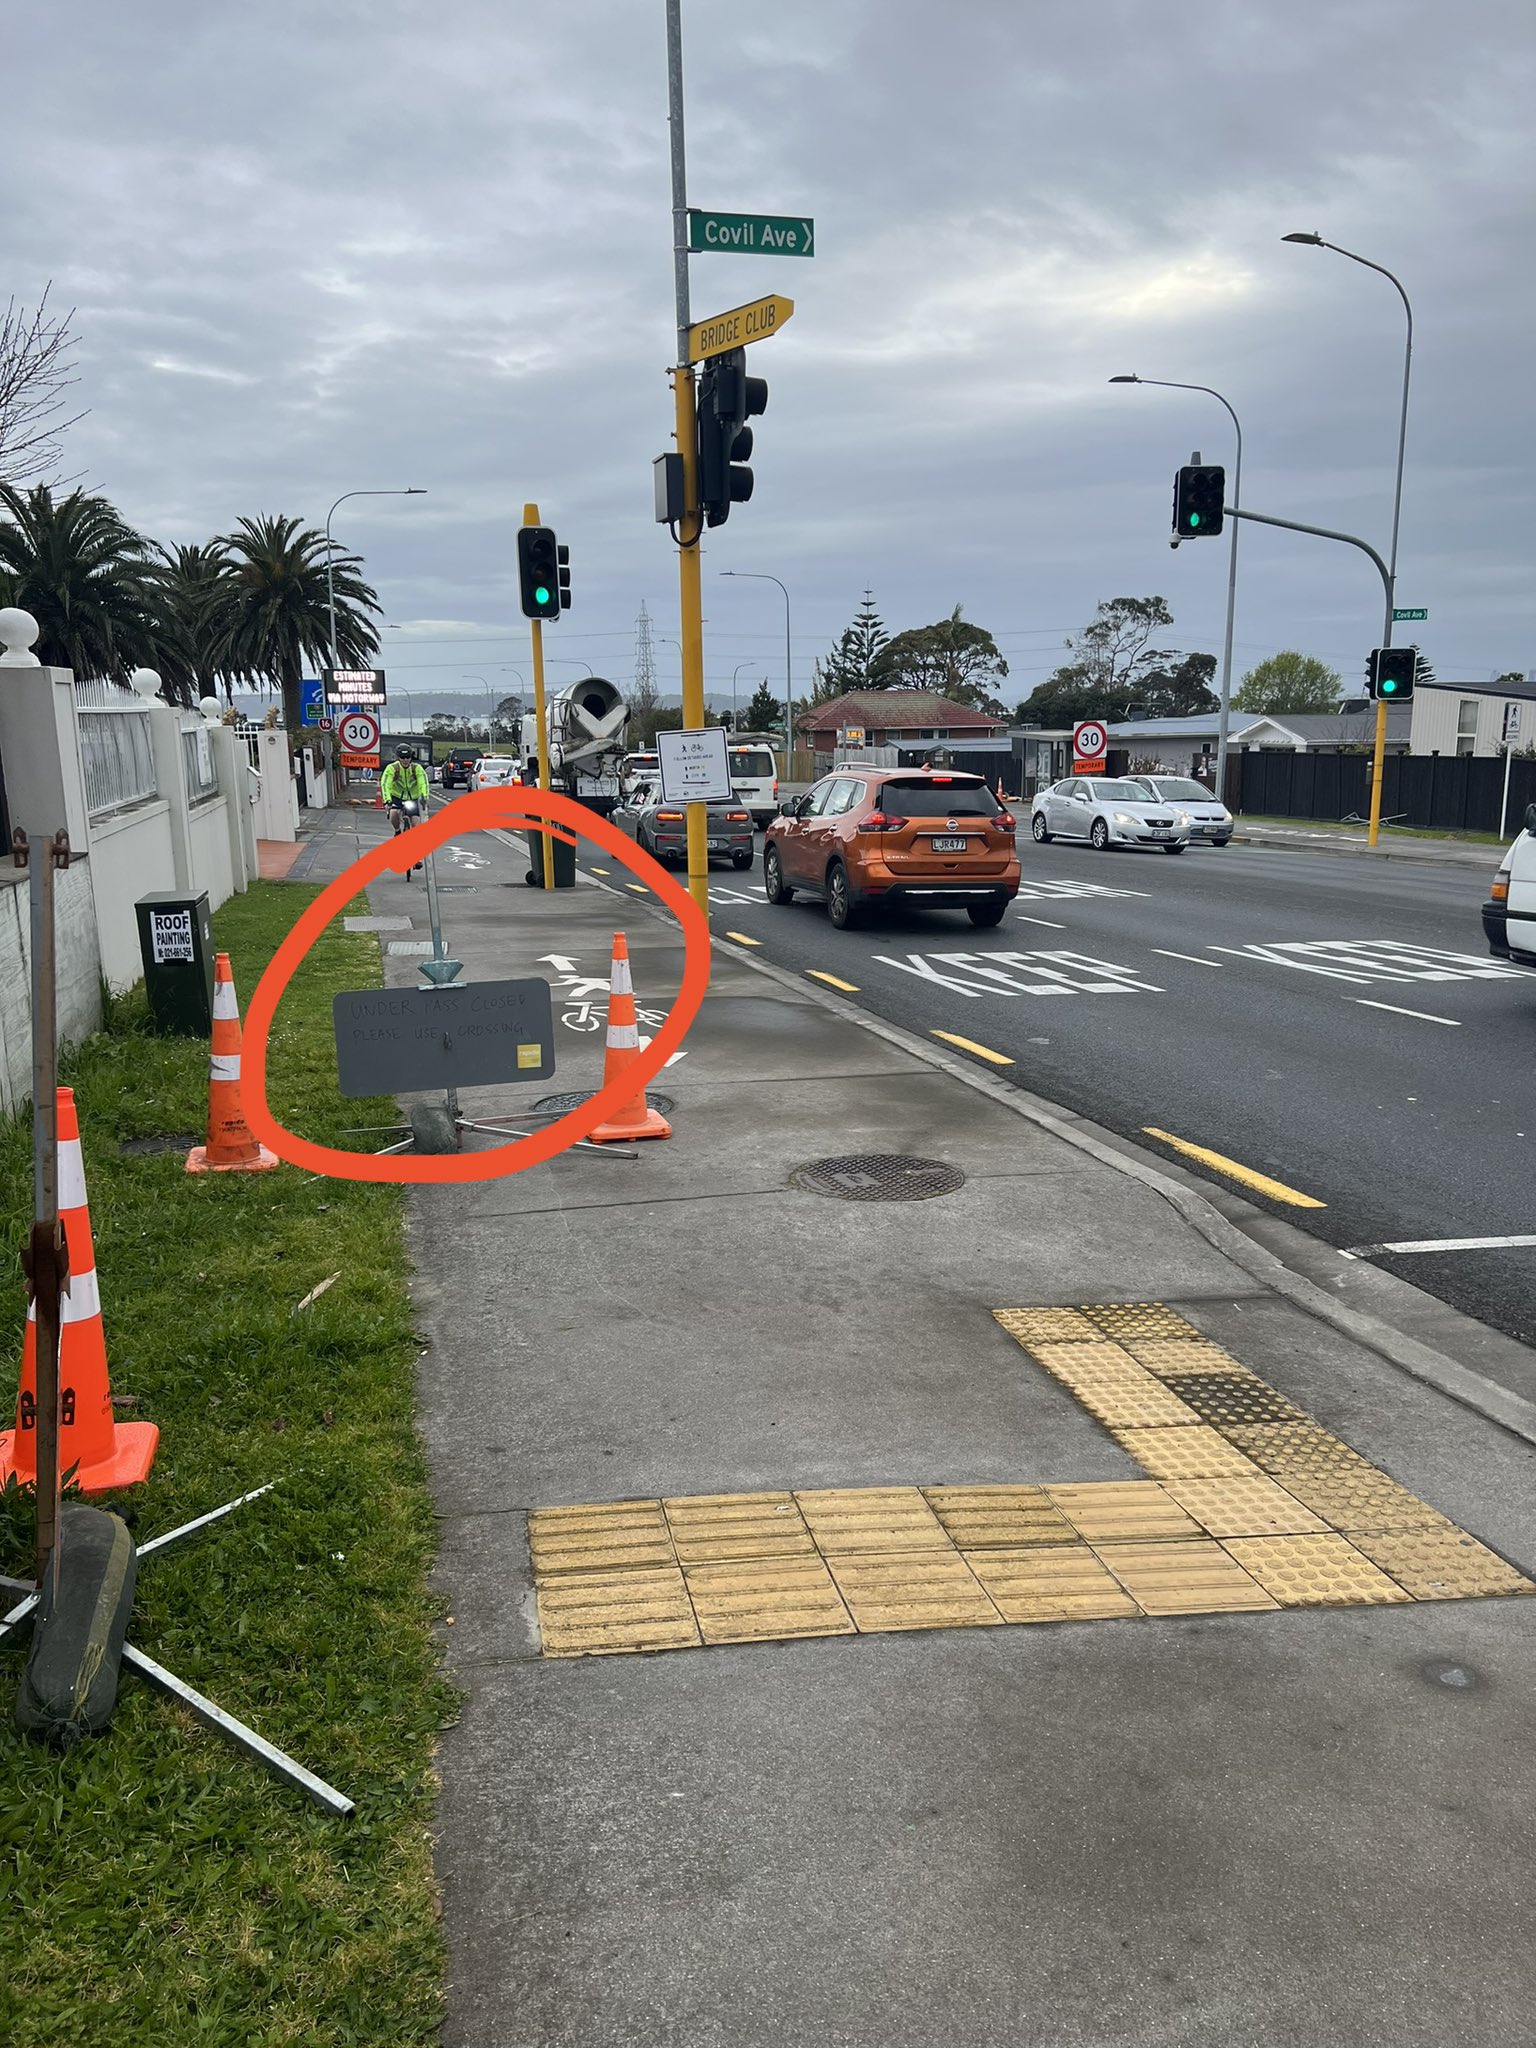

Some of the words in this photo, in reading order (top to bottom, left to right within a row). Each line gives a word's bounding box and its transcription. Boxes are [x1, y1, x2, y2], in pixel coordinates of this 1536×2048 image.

[704, 220, 754, 245] Covil
[760, 224, 797, 248] Ave
[701, 316, 740, 351] BRIDGE
[745, 304, 776, 336] CLUB
[1396, 611, 1411, 619] Covil
[333, 671, 376, 681] ESTIMATED
[338, 682, 372, 692] MINUTES
[327, 693, 341, 703] VIA
[342, 693, 385, 703] MOTORWAY
[348, 725, 370, 739] 30
[1081, 733, 1099, 746] 30
[343, 755, 377, 764] TEMPORARY
[1075, 762, 1104, 770] TEMPORARY
[155, 916, 189, 930] ROOF
[156, 932, 190, 945] PAINTING
[1206, 940, 1536, 984] KEEP
[871, 950, 1166, 998] KEEP
[351, 999, 416, 1020] UNDER
[425, 998, 460, 1013] PASS
[471, 994, 527, 1013] CLOSED
[352, 1027, 401, 1041] PLEASE
[415, 1027, 439, 1040] USE
[458, 1021, 524, 1037] CROSSING
